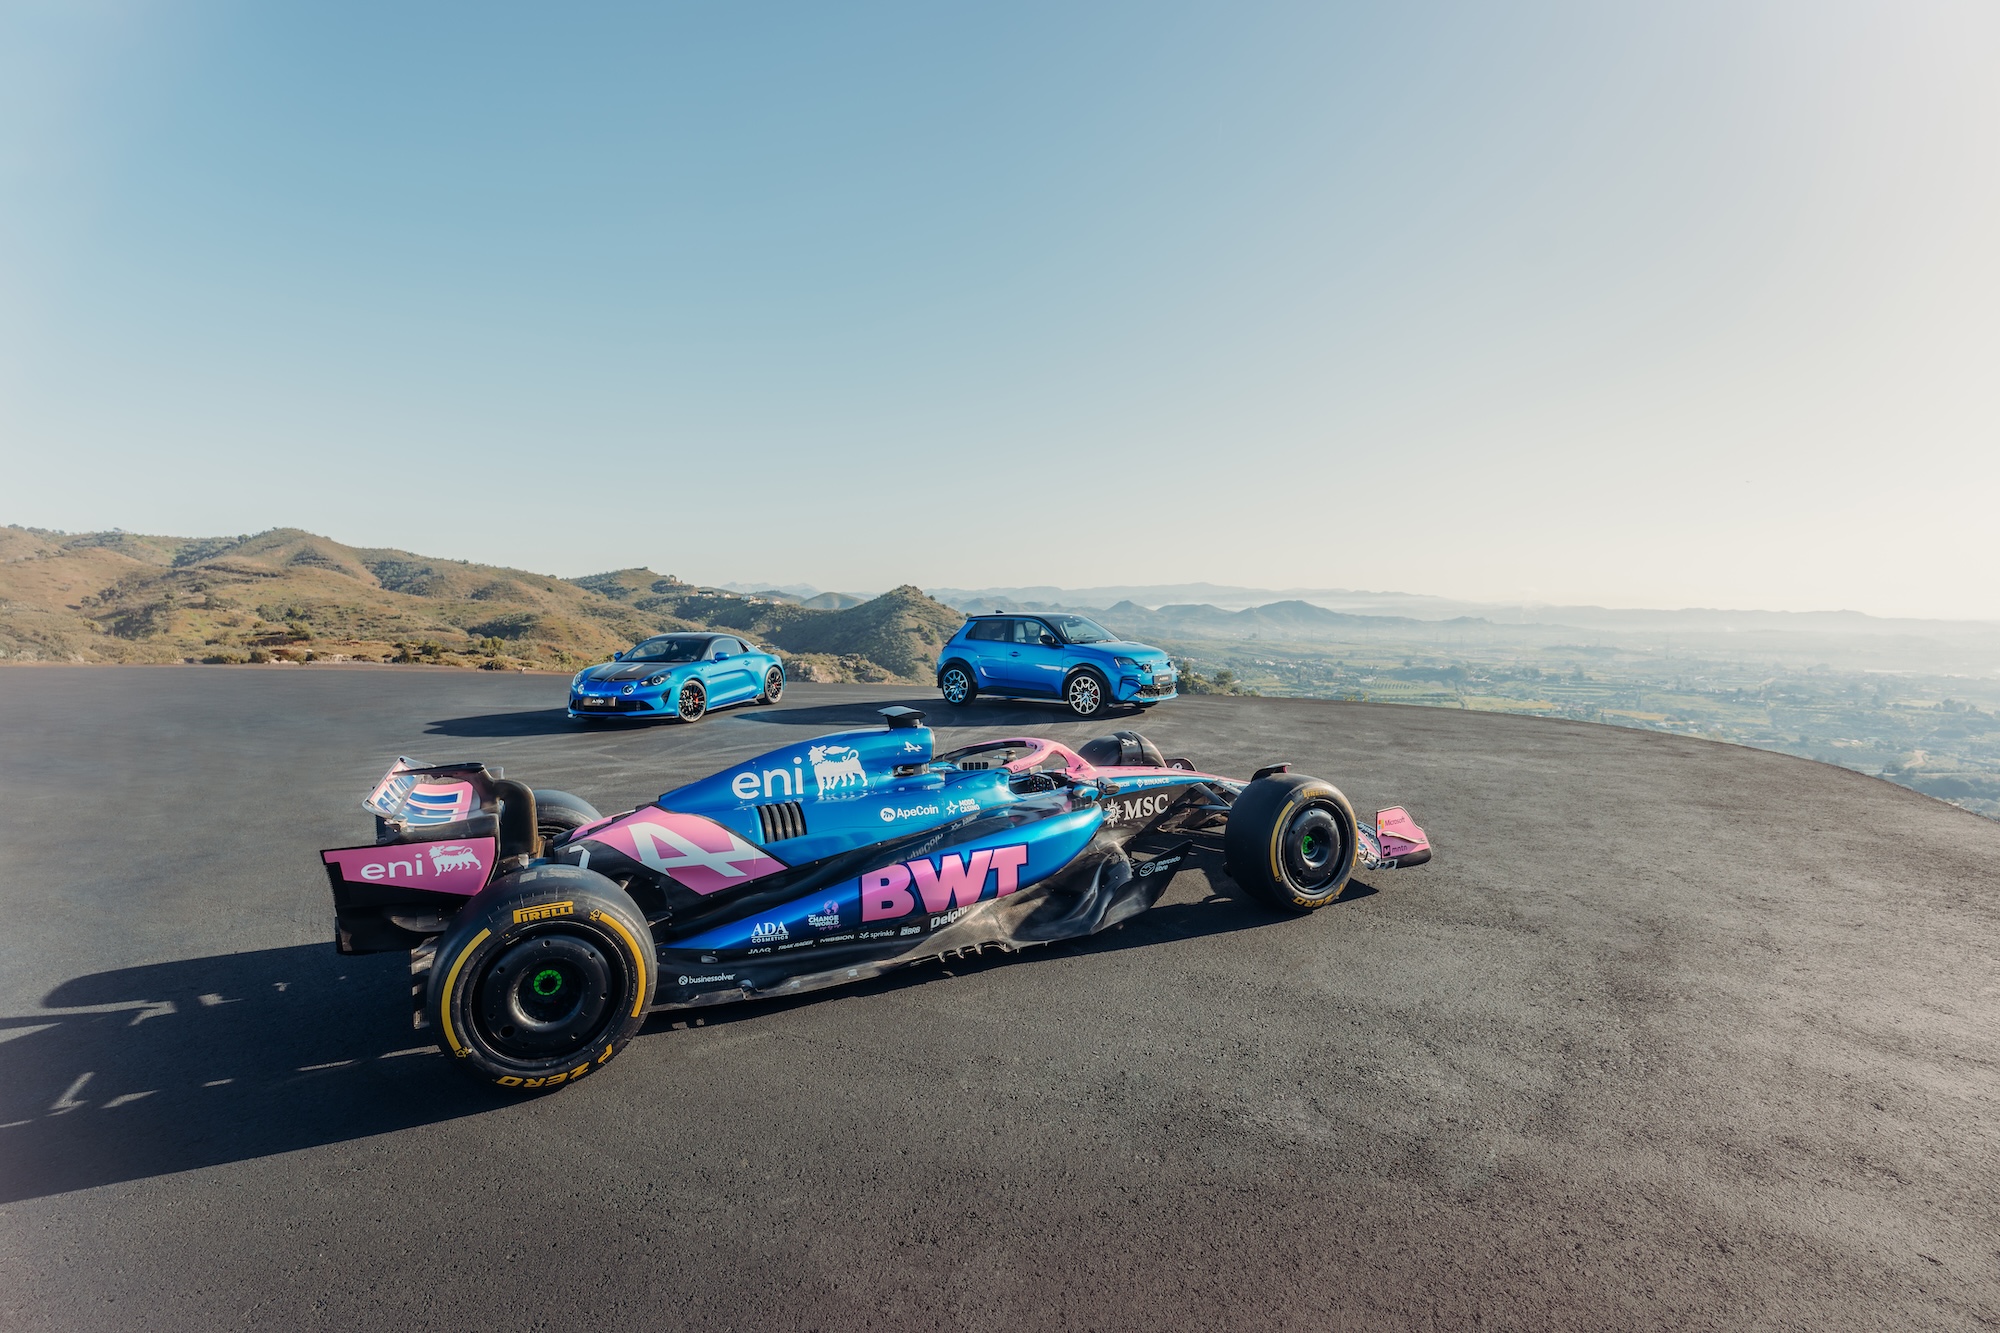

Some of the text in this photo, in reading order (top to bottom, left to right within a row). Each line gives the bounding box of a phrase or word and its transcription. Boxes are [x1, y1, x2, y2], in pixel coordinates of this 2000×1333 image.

[731, 757, 802, 799] eni
[1144, 778, 1169, 786] BINANCE
[1302, 787, 1329, 798] PIRELLI
[896, 804, 939, 819] ApeCoin
[960, 804, 980, 813] CASINO
[1123, 793, 1169, 821] MSC
[1385, 816, 1406, 827] Microsoft
[1391, 845, 1408, 853] mntn
[360, 853, 423, 880] eni
[1156, 856, 1181, 866] mercado
[860, 845, 1028, 923] BWT
[1292, 894, 1335, 908] ZERO
[512, 900, 574, 924] PIRELLI
[808, 915, 839, 923] CHANGE
[751, 921, 790, 936] ADA
[747, 947, 772, 955] JAAQ
[820, 934, 855, 943] MISSION
[870, 929, 895, 939] sprinklr
[751, 935, 788, 944] COSMETICS
[688, 972, 737, 984] businessolver
[496, 1043, 613, 1088] P ZERO
